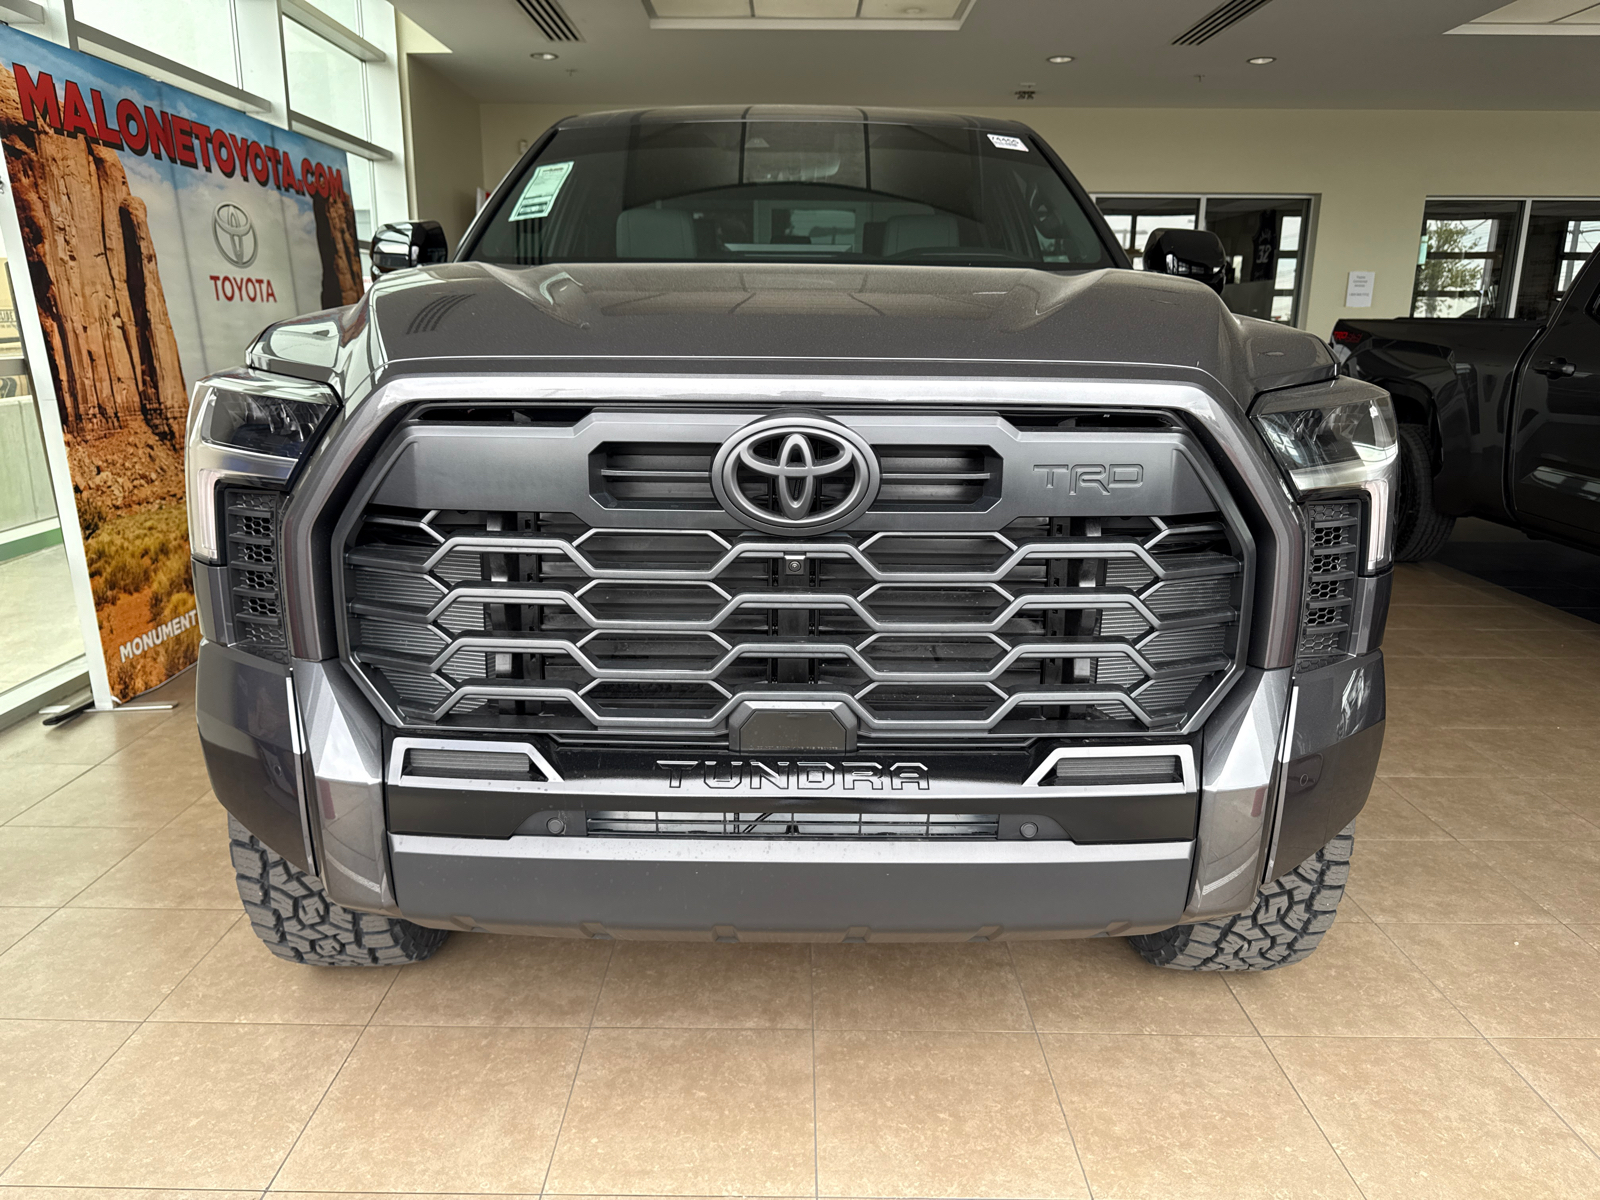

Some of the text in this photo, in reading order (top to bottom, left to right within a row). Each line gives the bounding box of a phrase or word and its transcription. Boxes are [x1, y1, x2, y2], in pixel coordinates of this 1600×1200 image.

[12, 62, 346, 203] MALONETOYOTA.COM
[1256, 244, 1272, 264] 32
[209, 275, 277, 303] TOYOTA
[1033, 464, 1144, 495] TRD
[119, 609, 197, 663] MONUMENT
[656, 760, 930, 790] TUNDRA
